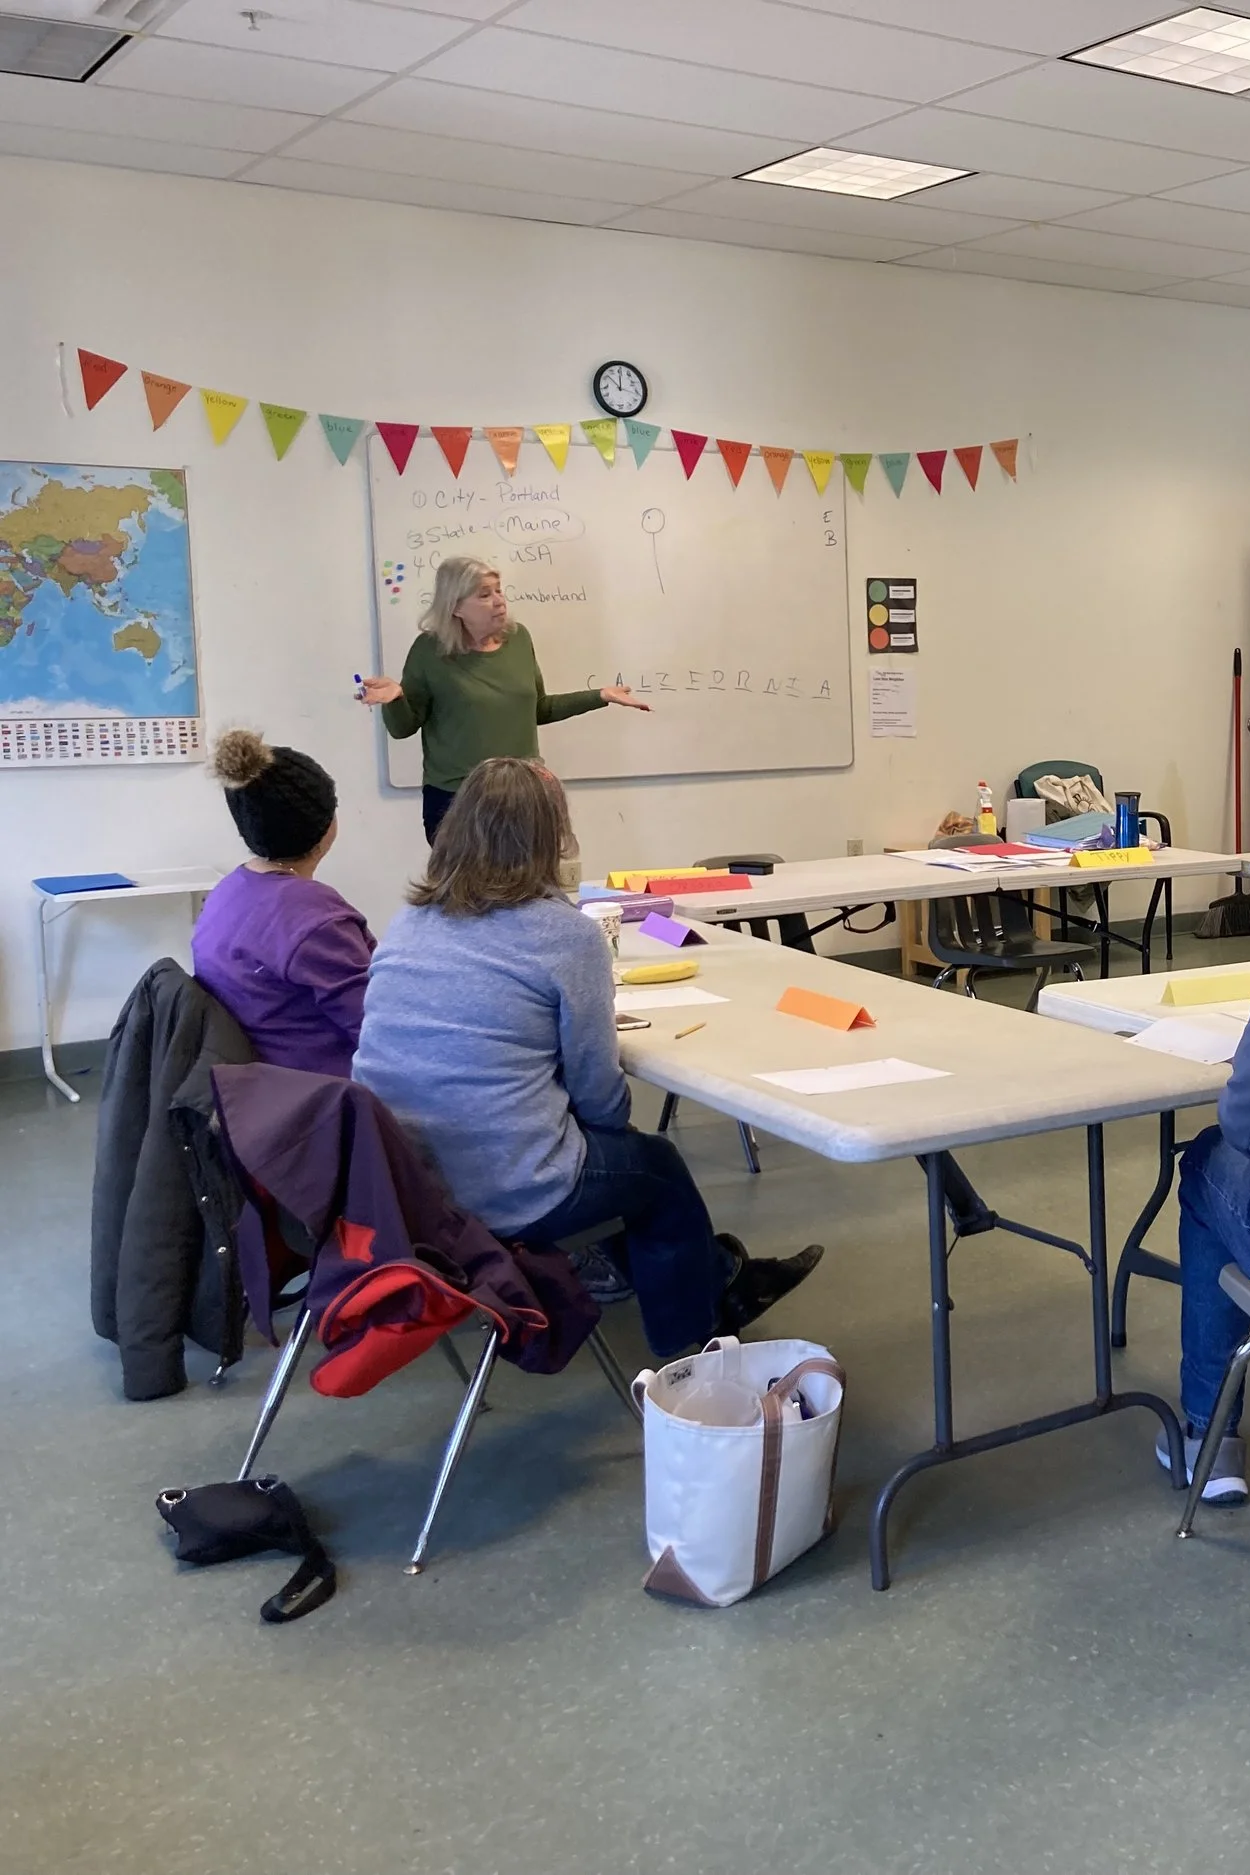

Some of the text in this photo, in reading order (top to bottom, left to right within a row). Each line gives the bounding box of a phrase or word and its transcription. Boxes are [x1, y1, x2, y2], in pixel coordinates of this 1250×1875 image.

[326, 421, 352, 433] blue
[631, 427, 651, 437] blue
[435, 489, 475, 511] City
[495, 482, 560, 502] Portland
[426, 525, 477, 543] State
[506, 515, 561, 533] Maine
[504, 585, 587, 603] Cumberland
